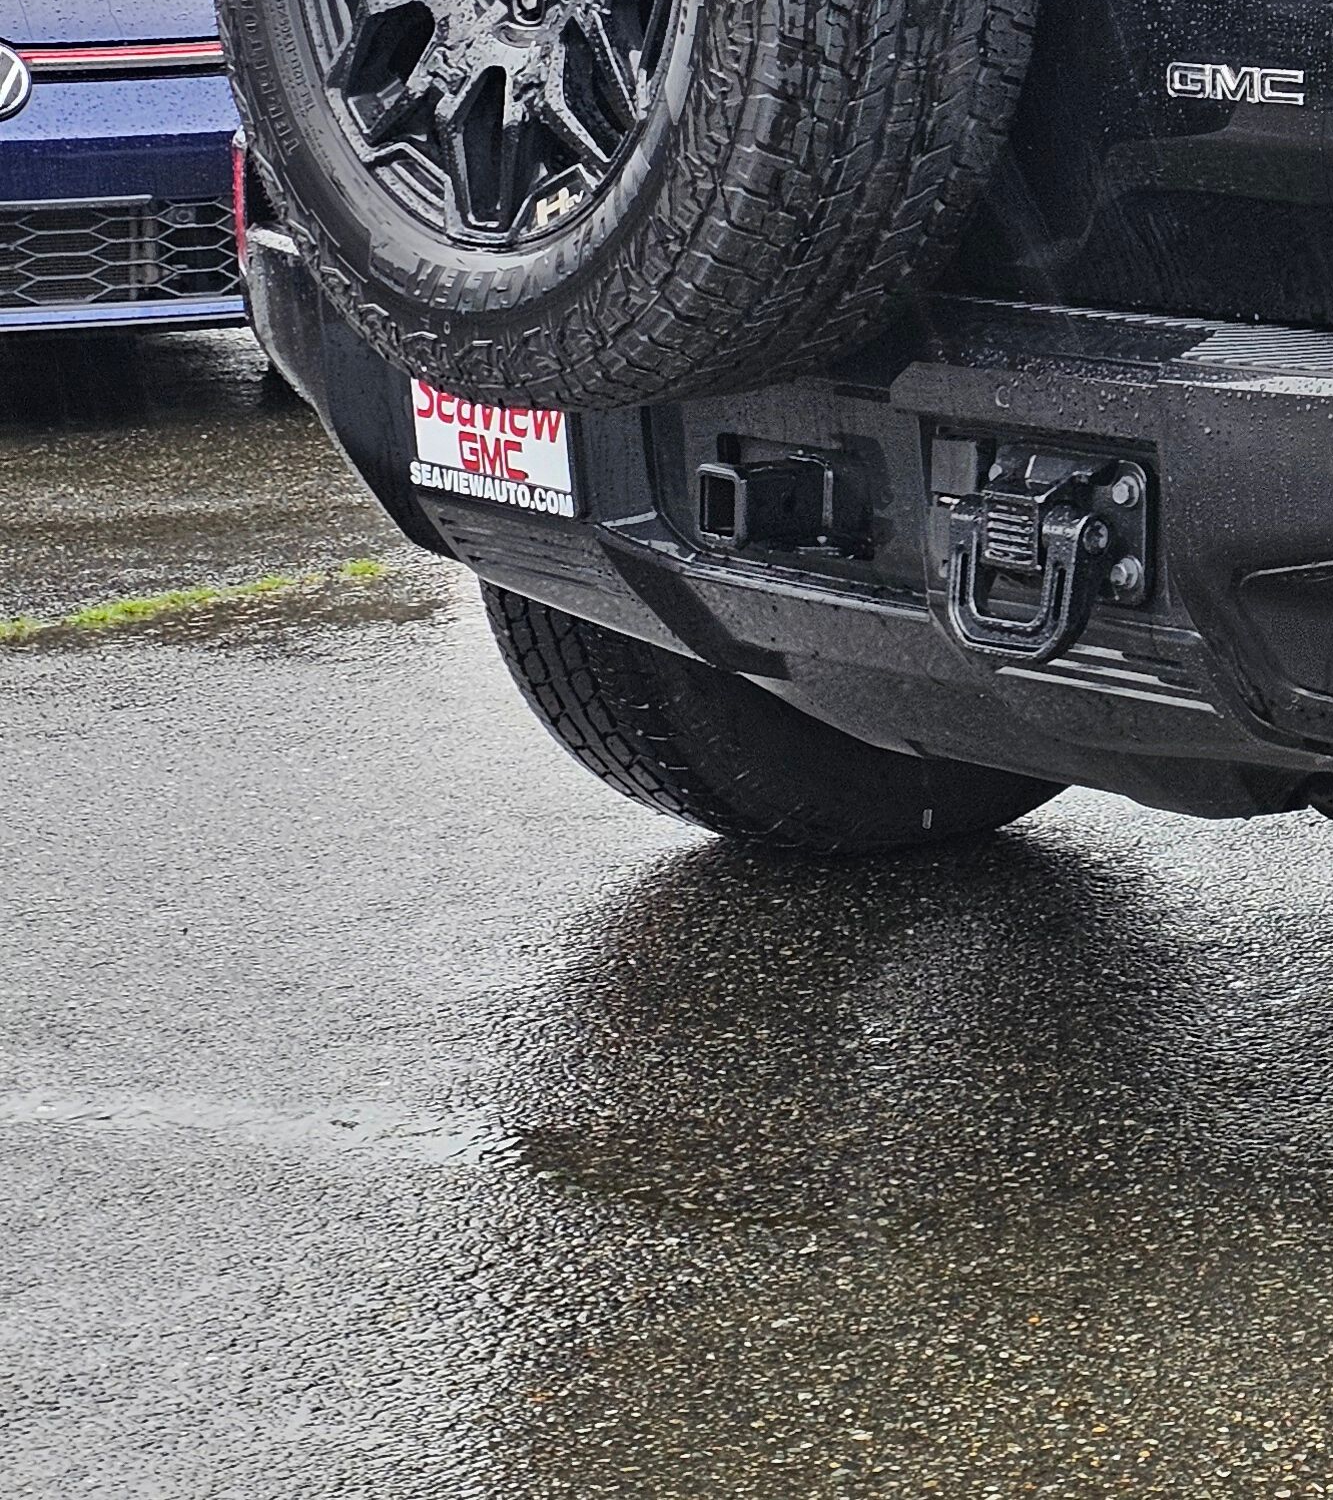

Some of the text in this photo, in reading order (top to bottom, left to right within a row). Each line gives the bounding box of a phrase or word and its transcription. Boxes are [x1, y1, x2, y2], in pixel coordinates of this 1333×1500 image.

[1166, 61, 1305, 105] GMC
[417, 379, 563, 444] Seaview
[458, 430, 529, 483] GMC
[409, 461, 574, 518] SEAVIEWAUTO.COM
